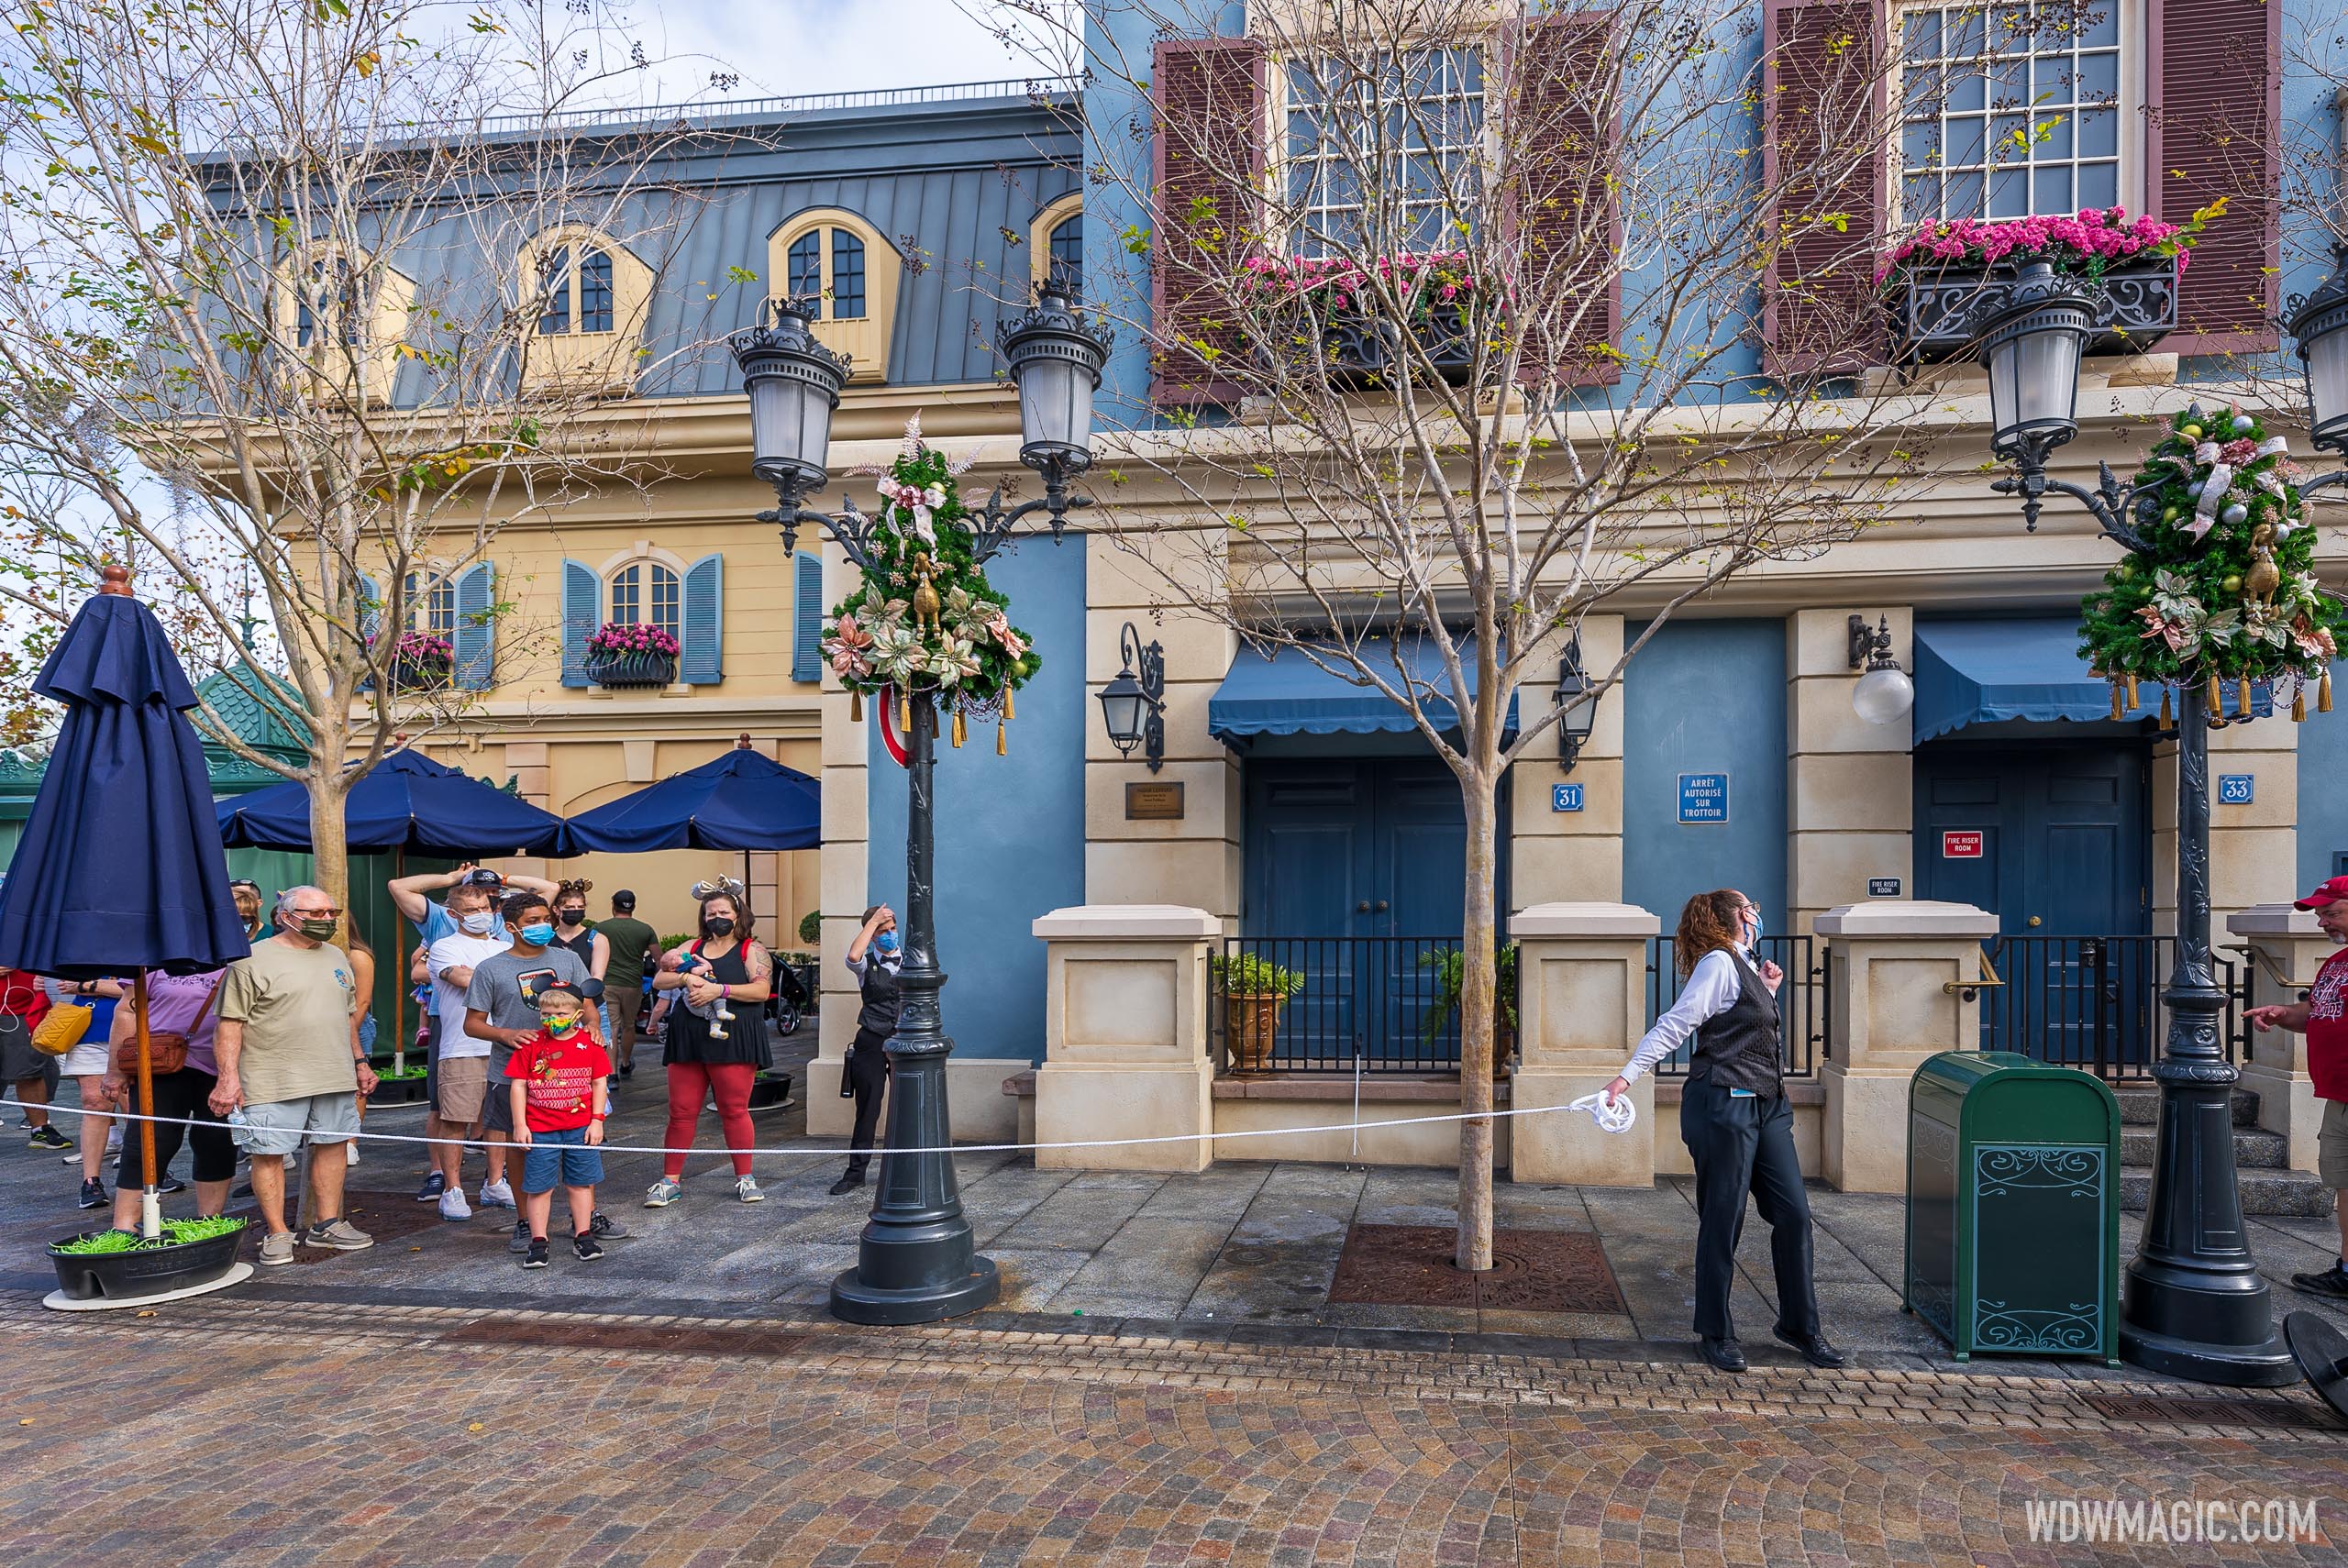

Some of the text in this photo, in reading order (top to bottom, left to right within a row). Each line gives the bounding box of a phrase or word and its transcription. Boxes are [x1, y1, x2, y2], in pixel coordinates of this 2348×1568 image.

[1691, 778, 1715, 788] ARRÊT
[1684, 787, 1722, 798] AUTORISÉ
[2226, 780, 2247, 798] 33
[1559, 789, 1576, 806] 31
[1695, 799, 1711, 807] SUR
[1684, 809, 1722, 817] TROTTOIR
